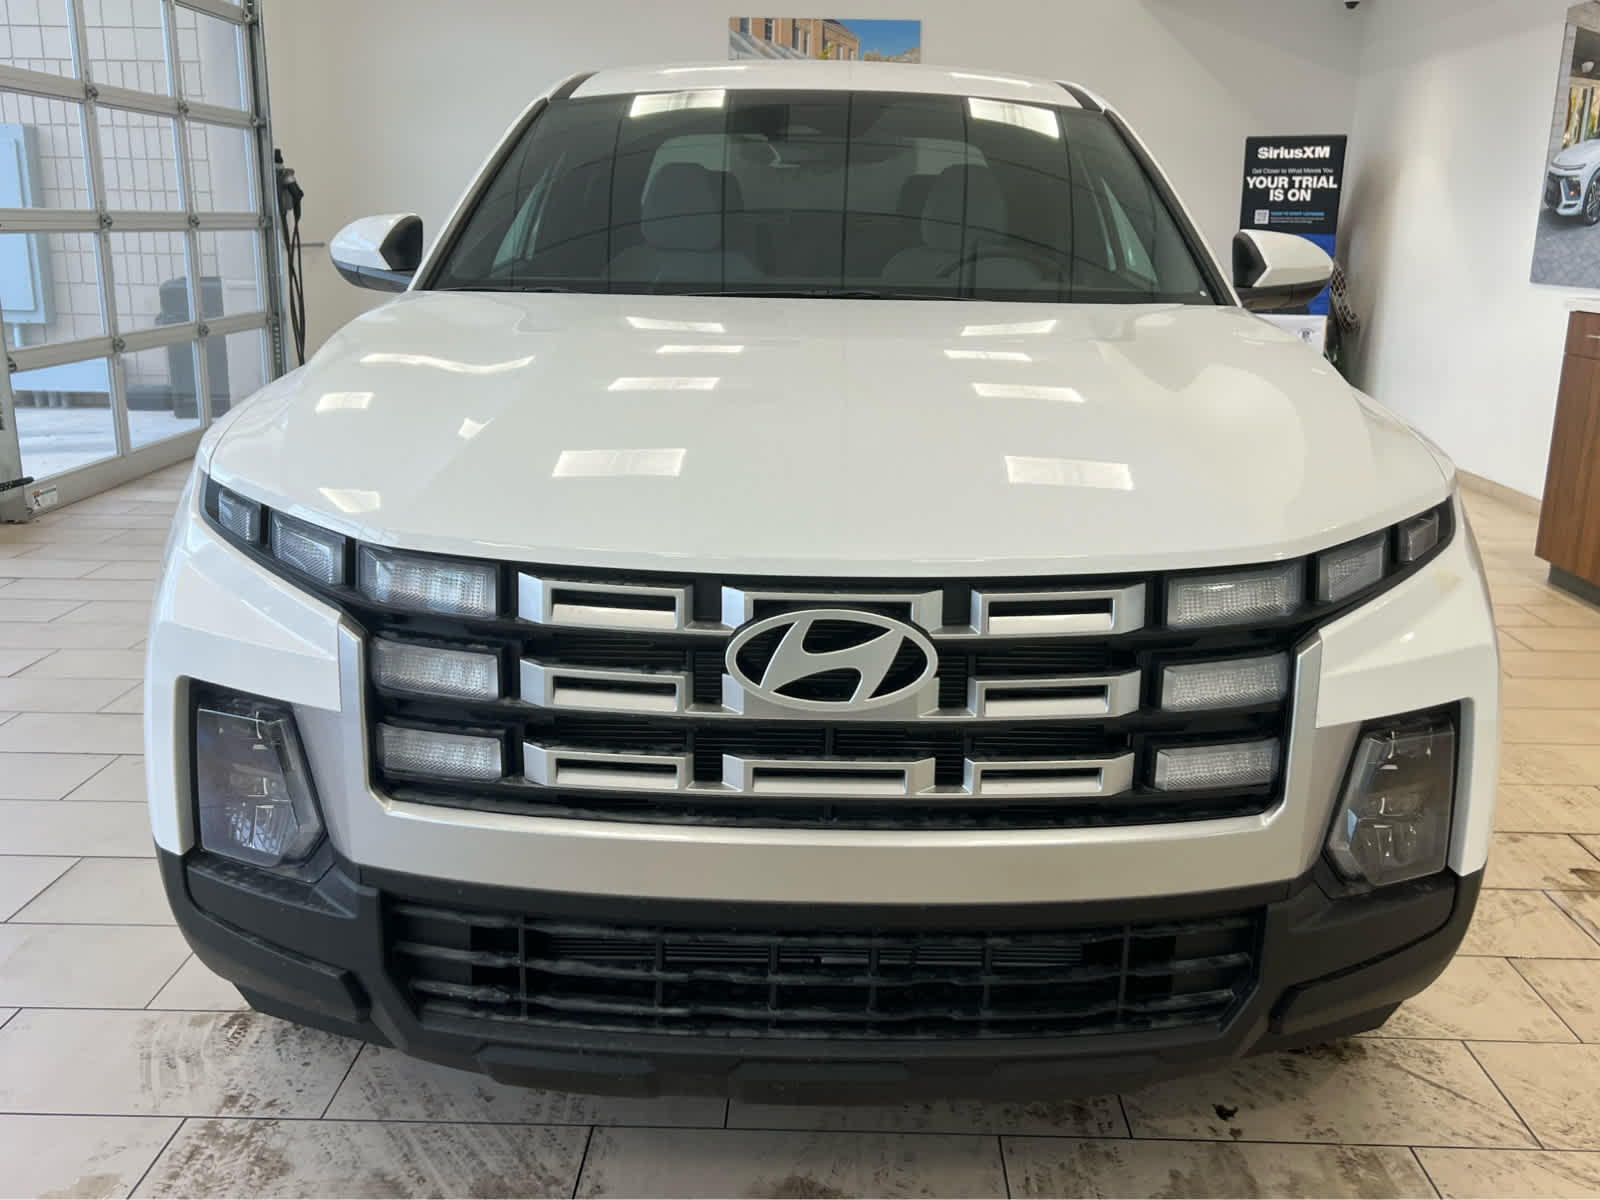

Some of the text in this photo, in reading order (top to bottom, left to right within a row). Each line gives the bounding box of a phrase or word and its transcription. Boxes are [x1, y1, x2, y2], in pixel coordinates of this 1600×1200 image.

[1257, 146, 1331, 159] SiriusXM
[1246, 176, 1338, 189] YOUR TRIAL
[1269, 189, 1312, 201] IS ON
